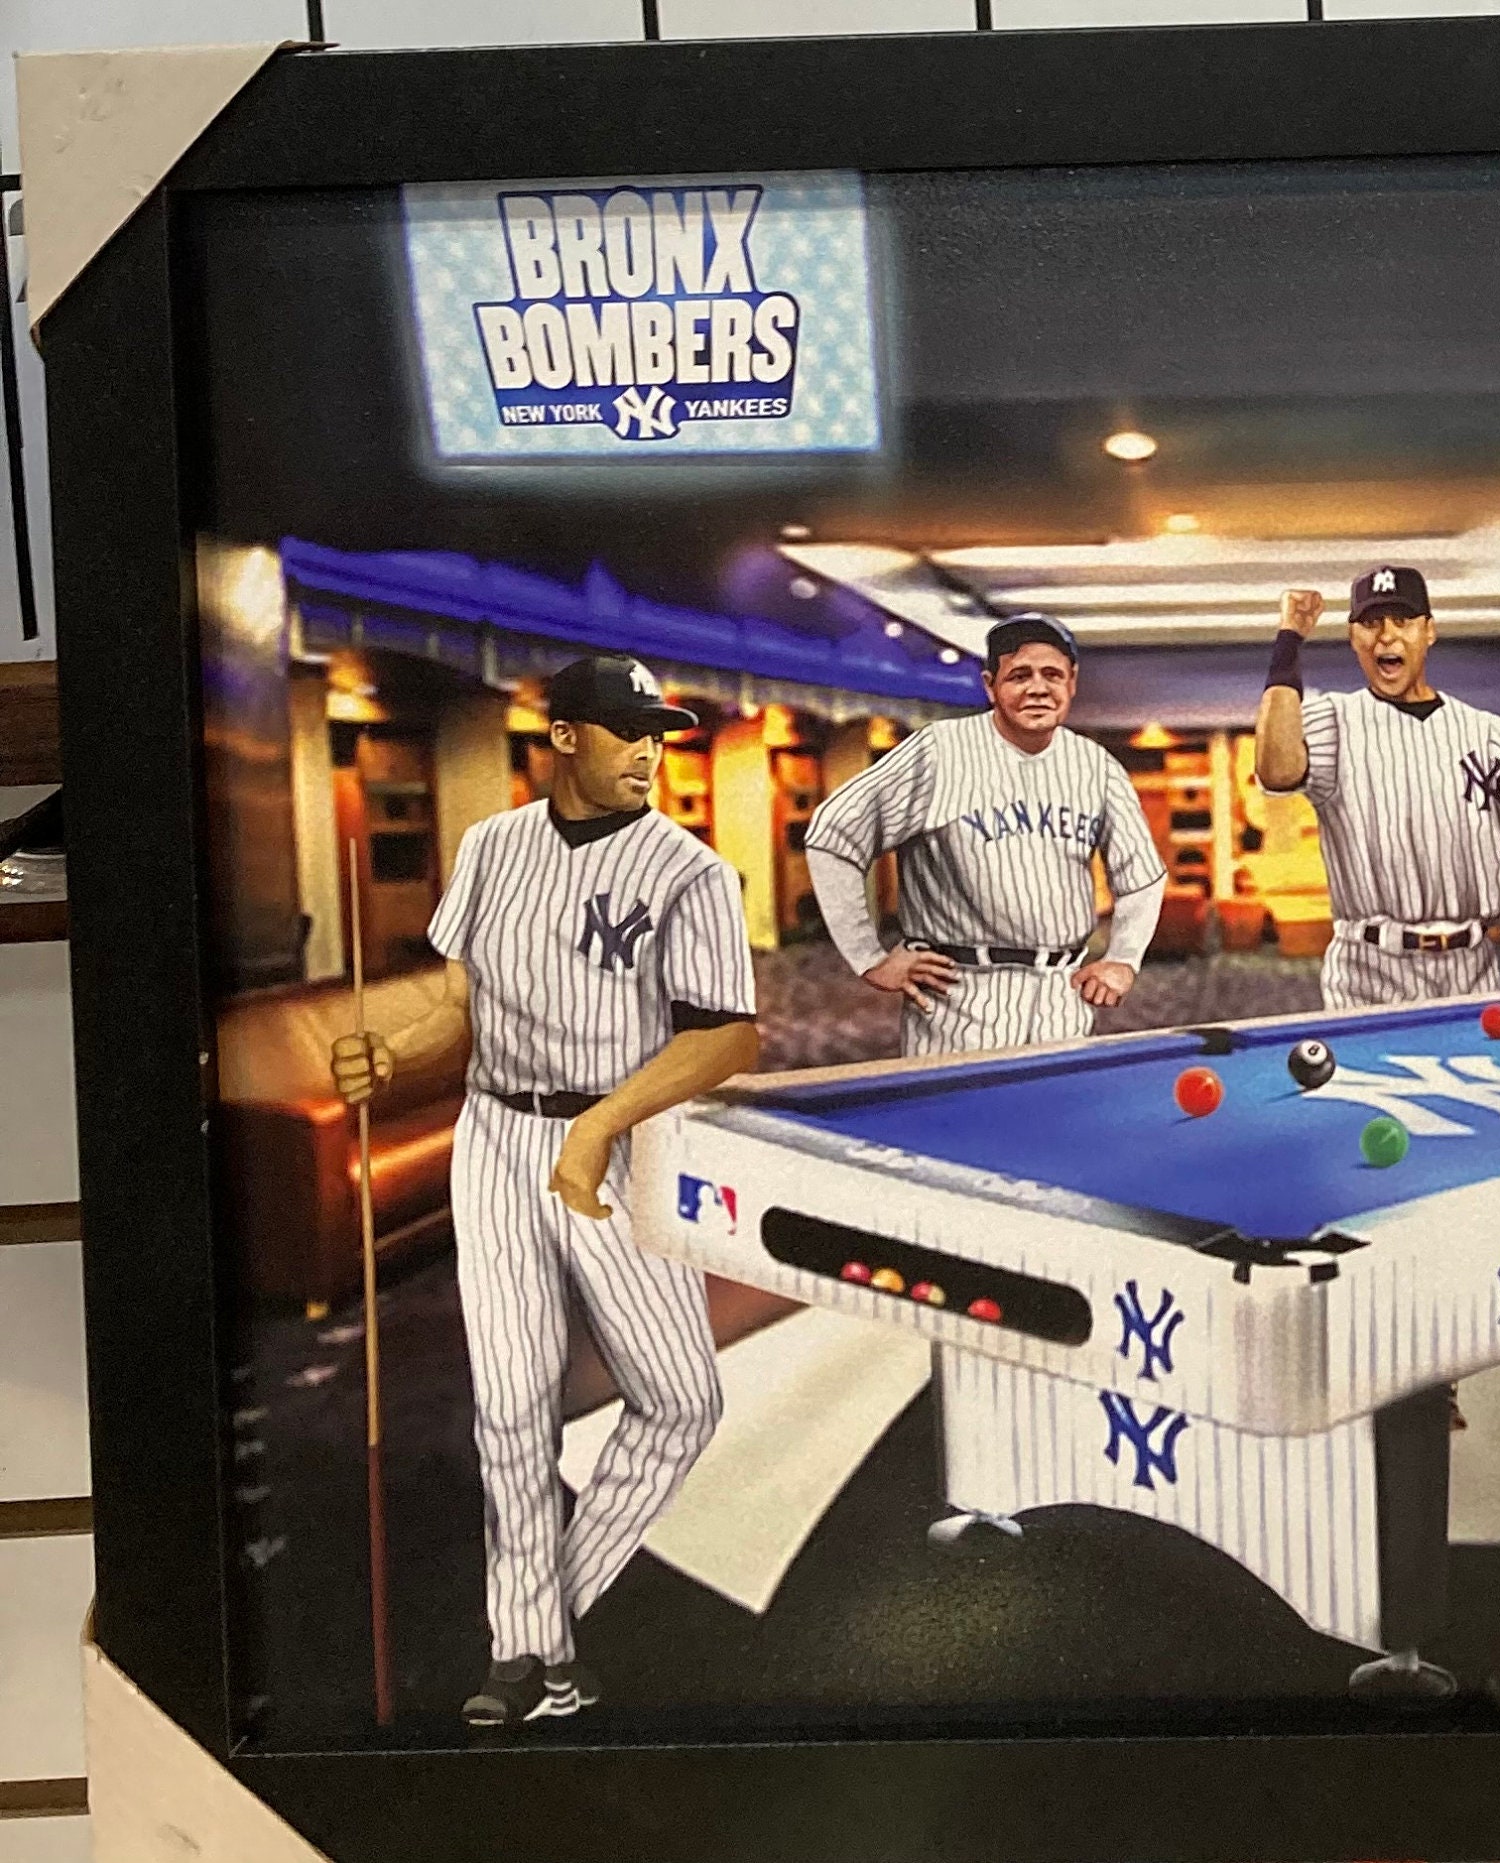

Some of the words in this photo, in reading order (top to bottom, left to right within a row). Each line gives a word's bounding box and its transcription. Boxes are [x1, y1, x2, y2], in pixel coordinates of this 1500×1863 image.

[502, 190, 761, 299] BRONX
[477, 296, 796, 390] BOMBERS
[502, 405, 545, 424] NEW
[549, 403, 604, 422] YORK
[612, 386, 678, 439] NY
[684, 398, 788, 418] YANKEES
[577, 893, 654, 972] NY
[1114, 1278, 1186, 1382] NY
[1098, 1388, 1190, 1491] NY
